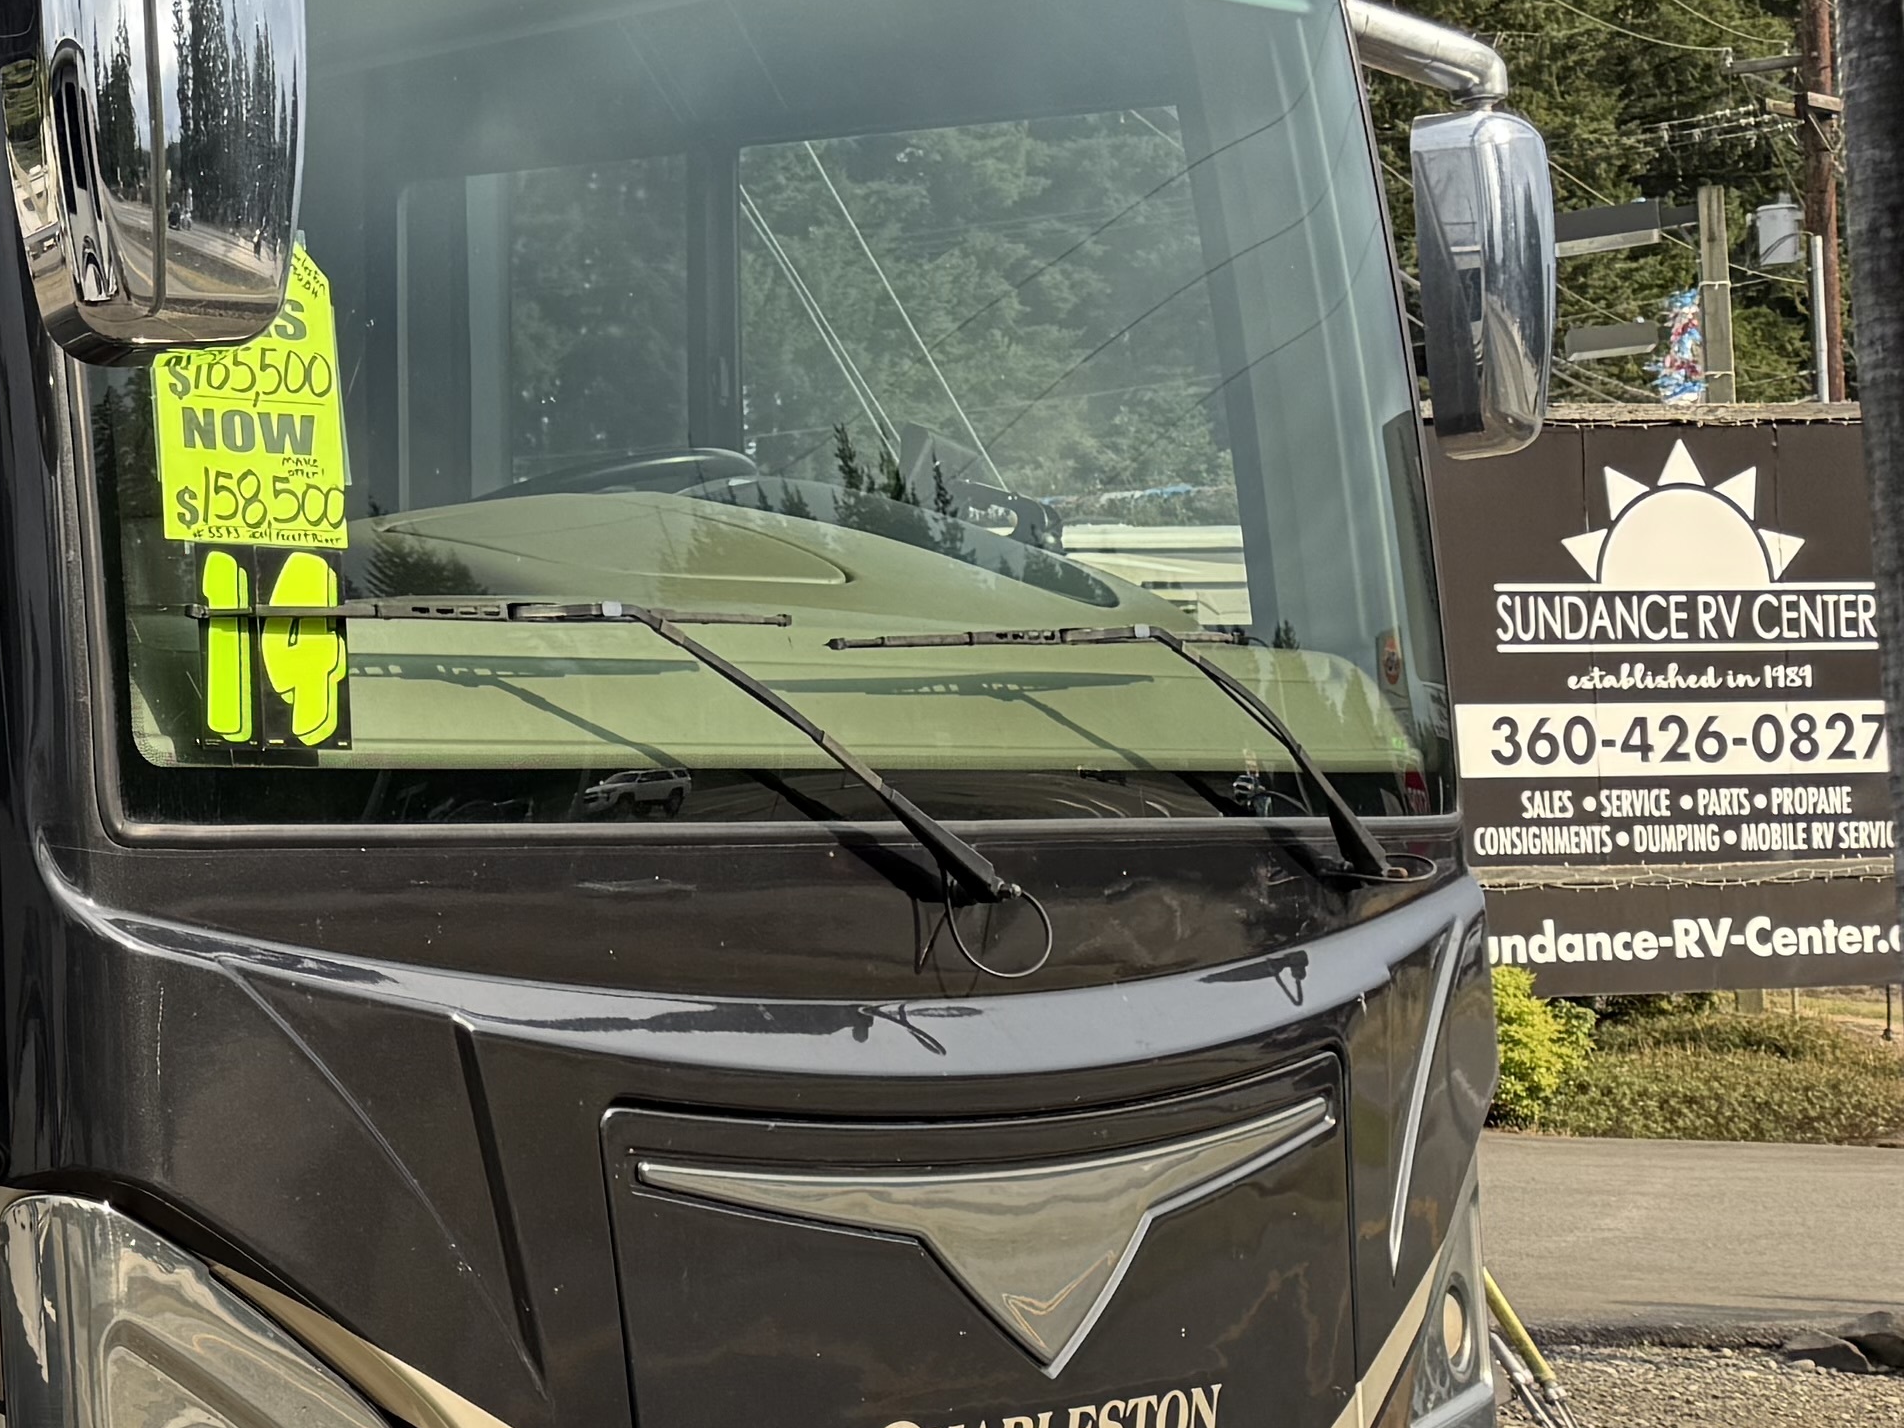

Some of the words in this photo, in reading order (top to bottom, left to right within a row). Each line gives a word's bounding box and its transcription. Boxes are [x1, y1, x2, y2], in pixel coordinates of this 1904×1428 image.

[181, 407, 315, 456] NOW
[176, 466, 344, 529] $158,500
[1496, 593, 1689, 642] SUNDANCE
[1697, 594, 1742, 640] RV
[1752, 593, 1879, 640] CENTER
[203, 550, 347, 747] 14
[1567, 662, 1723, 690] established
[1726, 669, 1761, 689] in
[1763, 663, 1814, 689] 1989
[1491, 712, 1887, 766] 360-426-0827
[1520, 789, 1574, 819] SALES
[1599, 788, 1672, 818] SERVICE
[1697, 787, 1751, 817] PARTS
[1770, 785, 1853, 815] PROPANE
[1473, 824, 1614, 856] CONSIGNMENTS
[1633, 823, 1721, 854] DUMPING
[1740, 822, 1809, 851] MOBILE
[1811, 821, 1835, 850] RV
